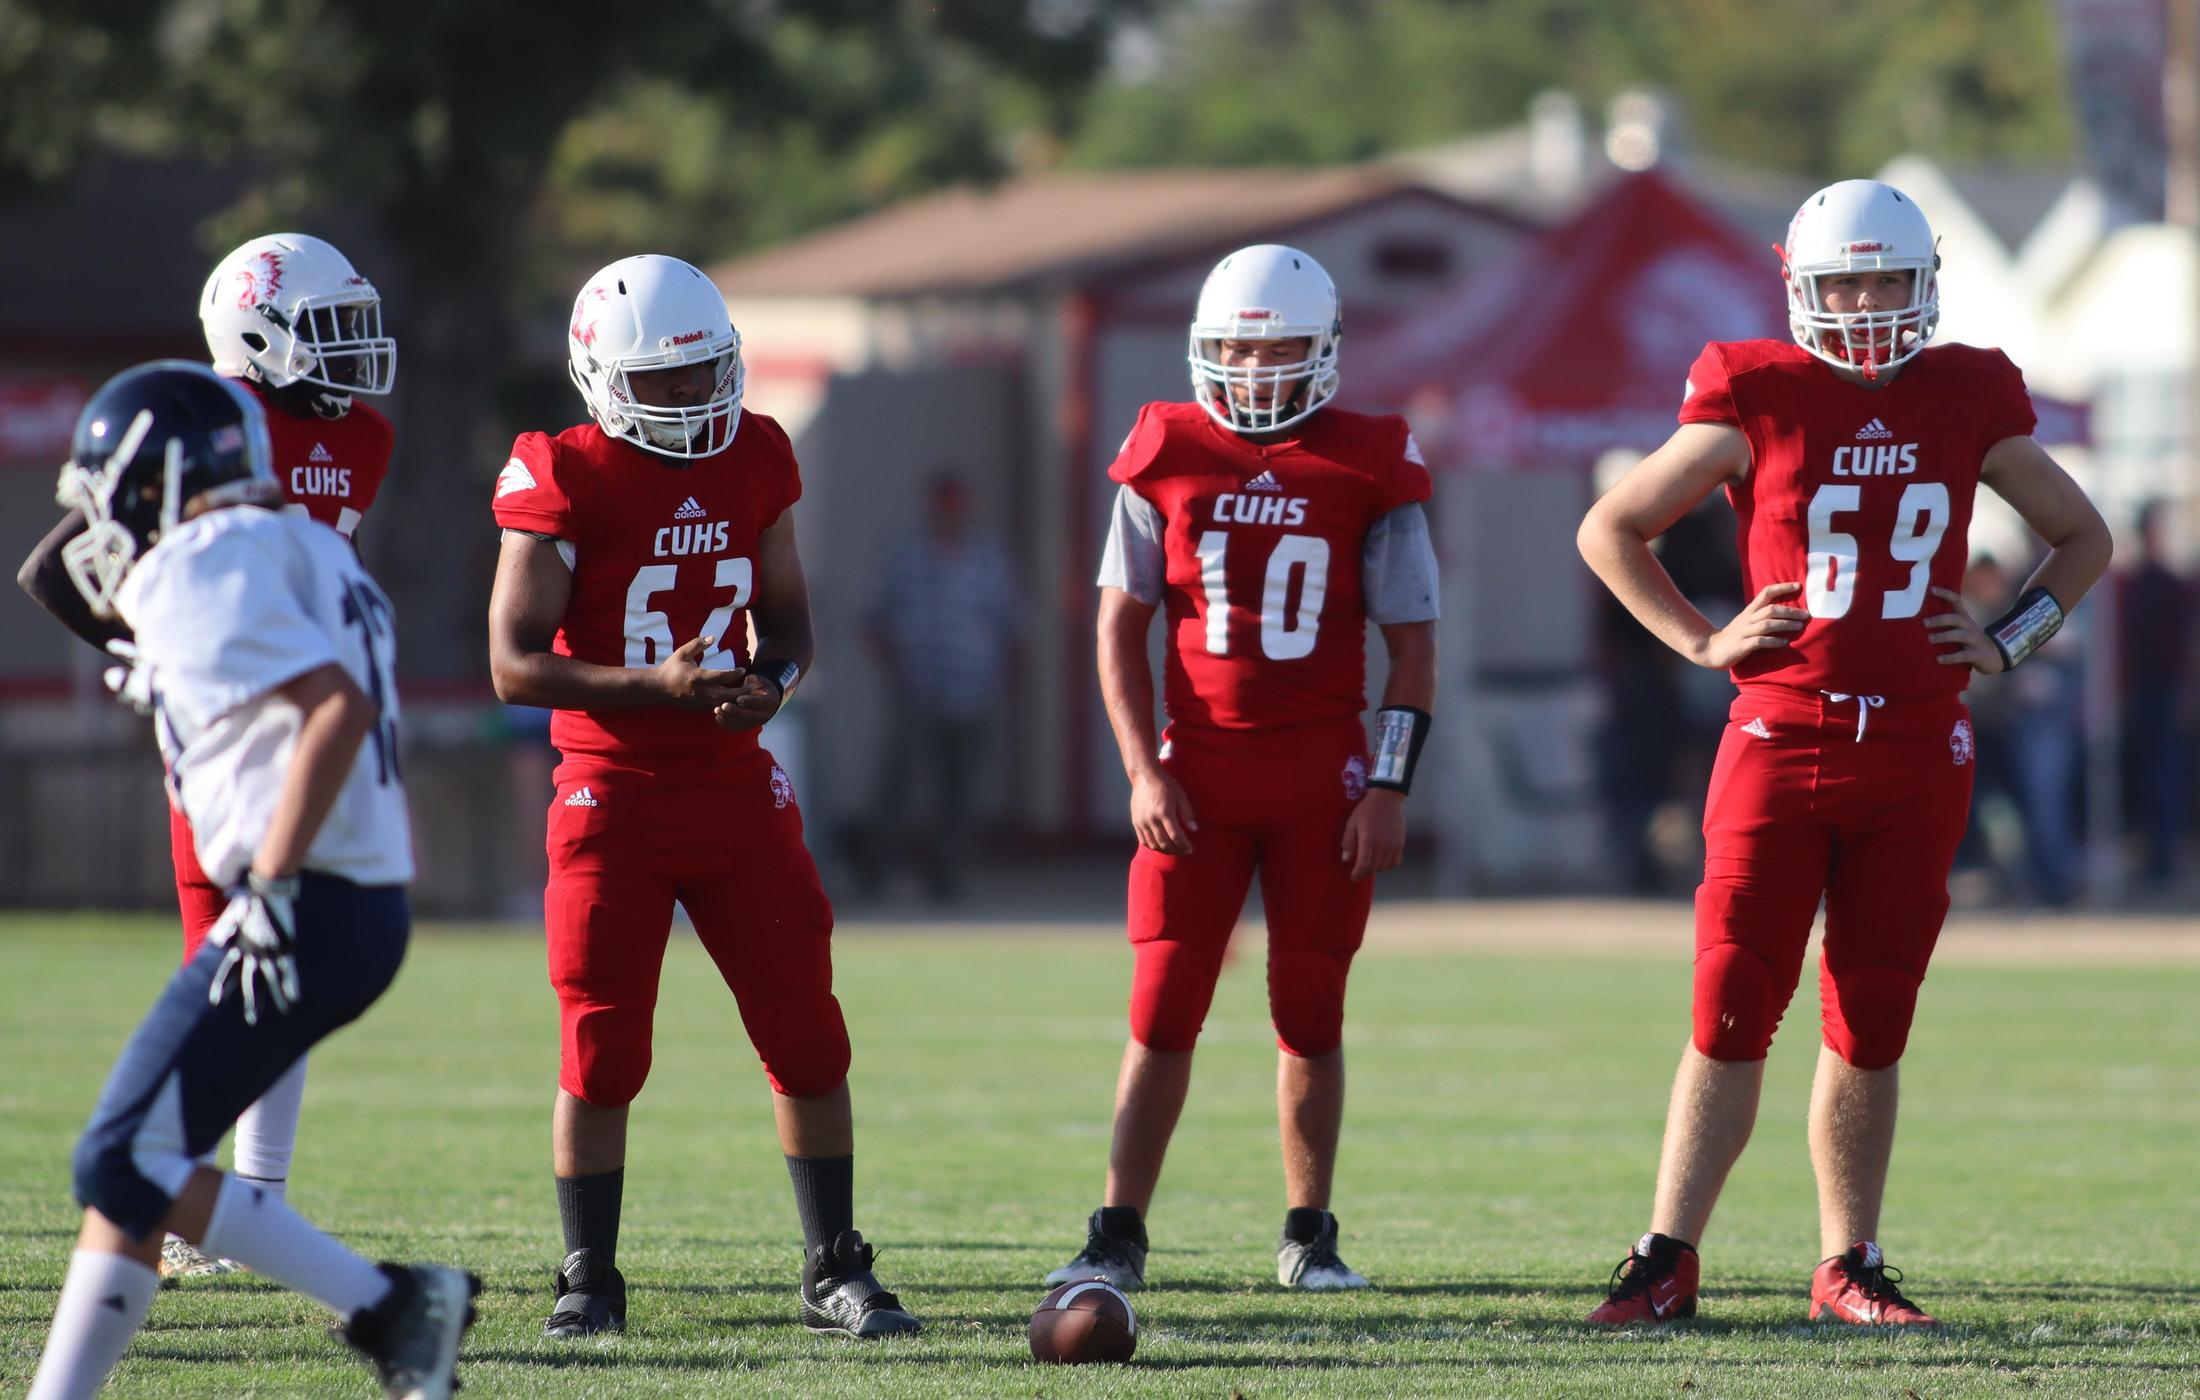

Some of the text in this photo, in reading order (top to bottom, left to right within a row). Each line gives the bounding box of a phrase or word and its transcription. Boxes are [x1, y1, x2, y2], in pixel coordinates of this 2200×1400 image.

[673, 330, 704, 346] Riddell
[1855, 430, 1893, 440] adidas
[1833, 443, 1918, 476] CUHS
[291, 467, 351, 497] CUHS
[674, 509, 707, 520] adidas
[1213, 493, 1308, 525] CUHS
[654, 521, 729, 557] CUHS
[1806, 482, 1950, 619] 69
[1195, 531, 1330, 660] 10
[624, 557, 752, 671] 62
[565, 797, 598, 807] adidas
